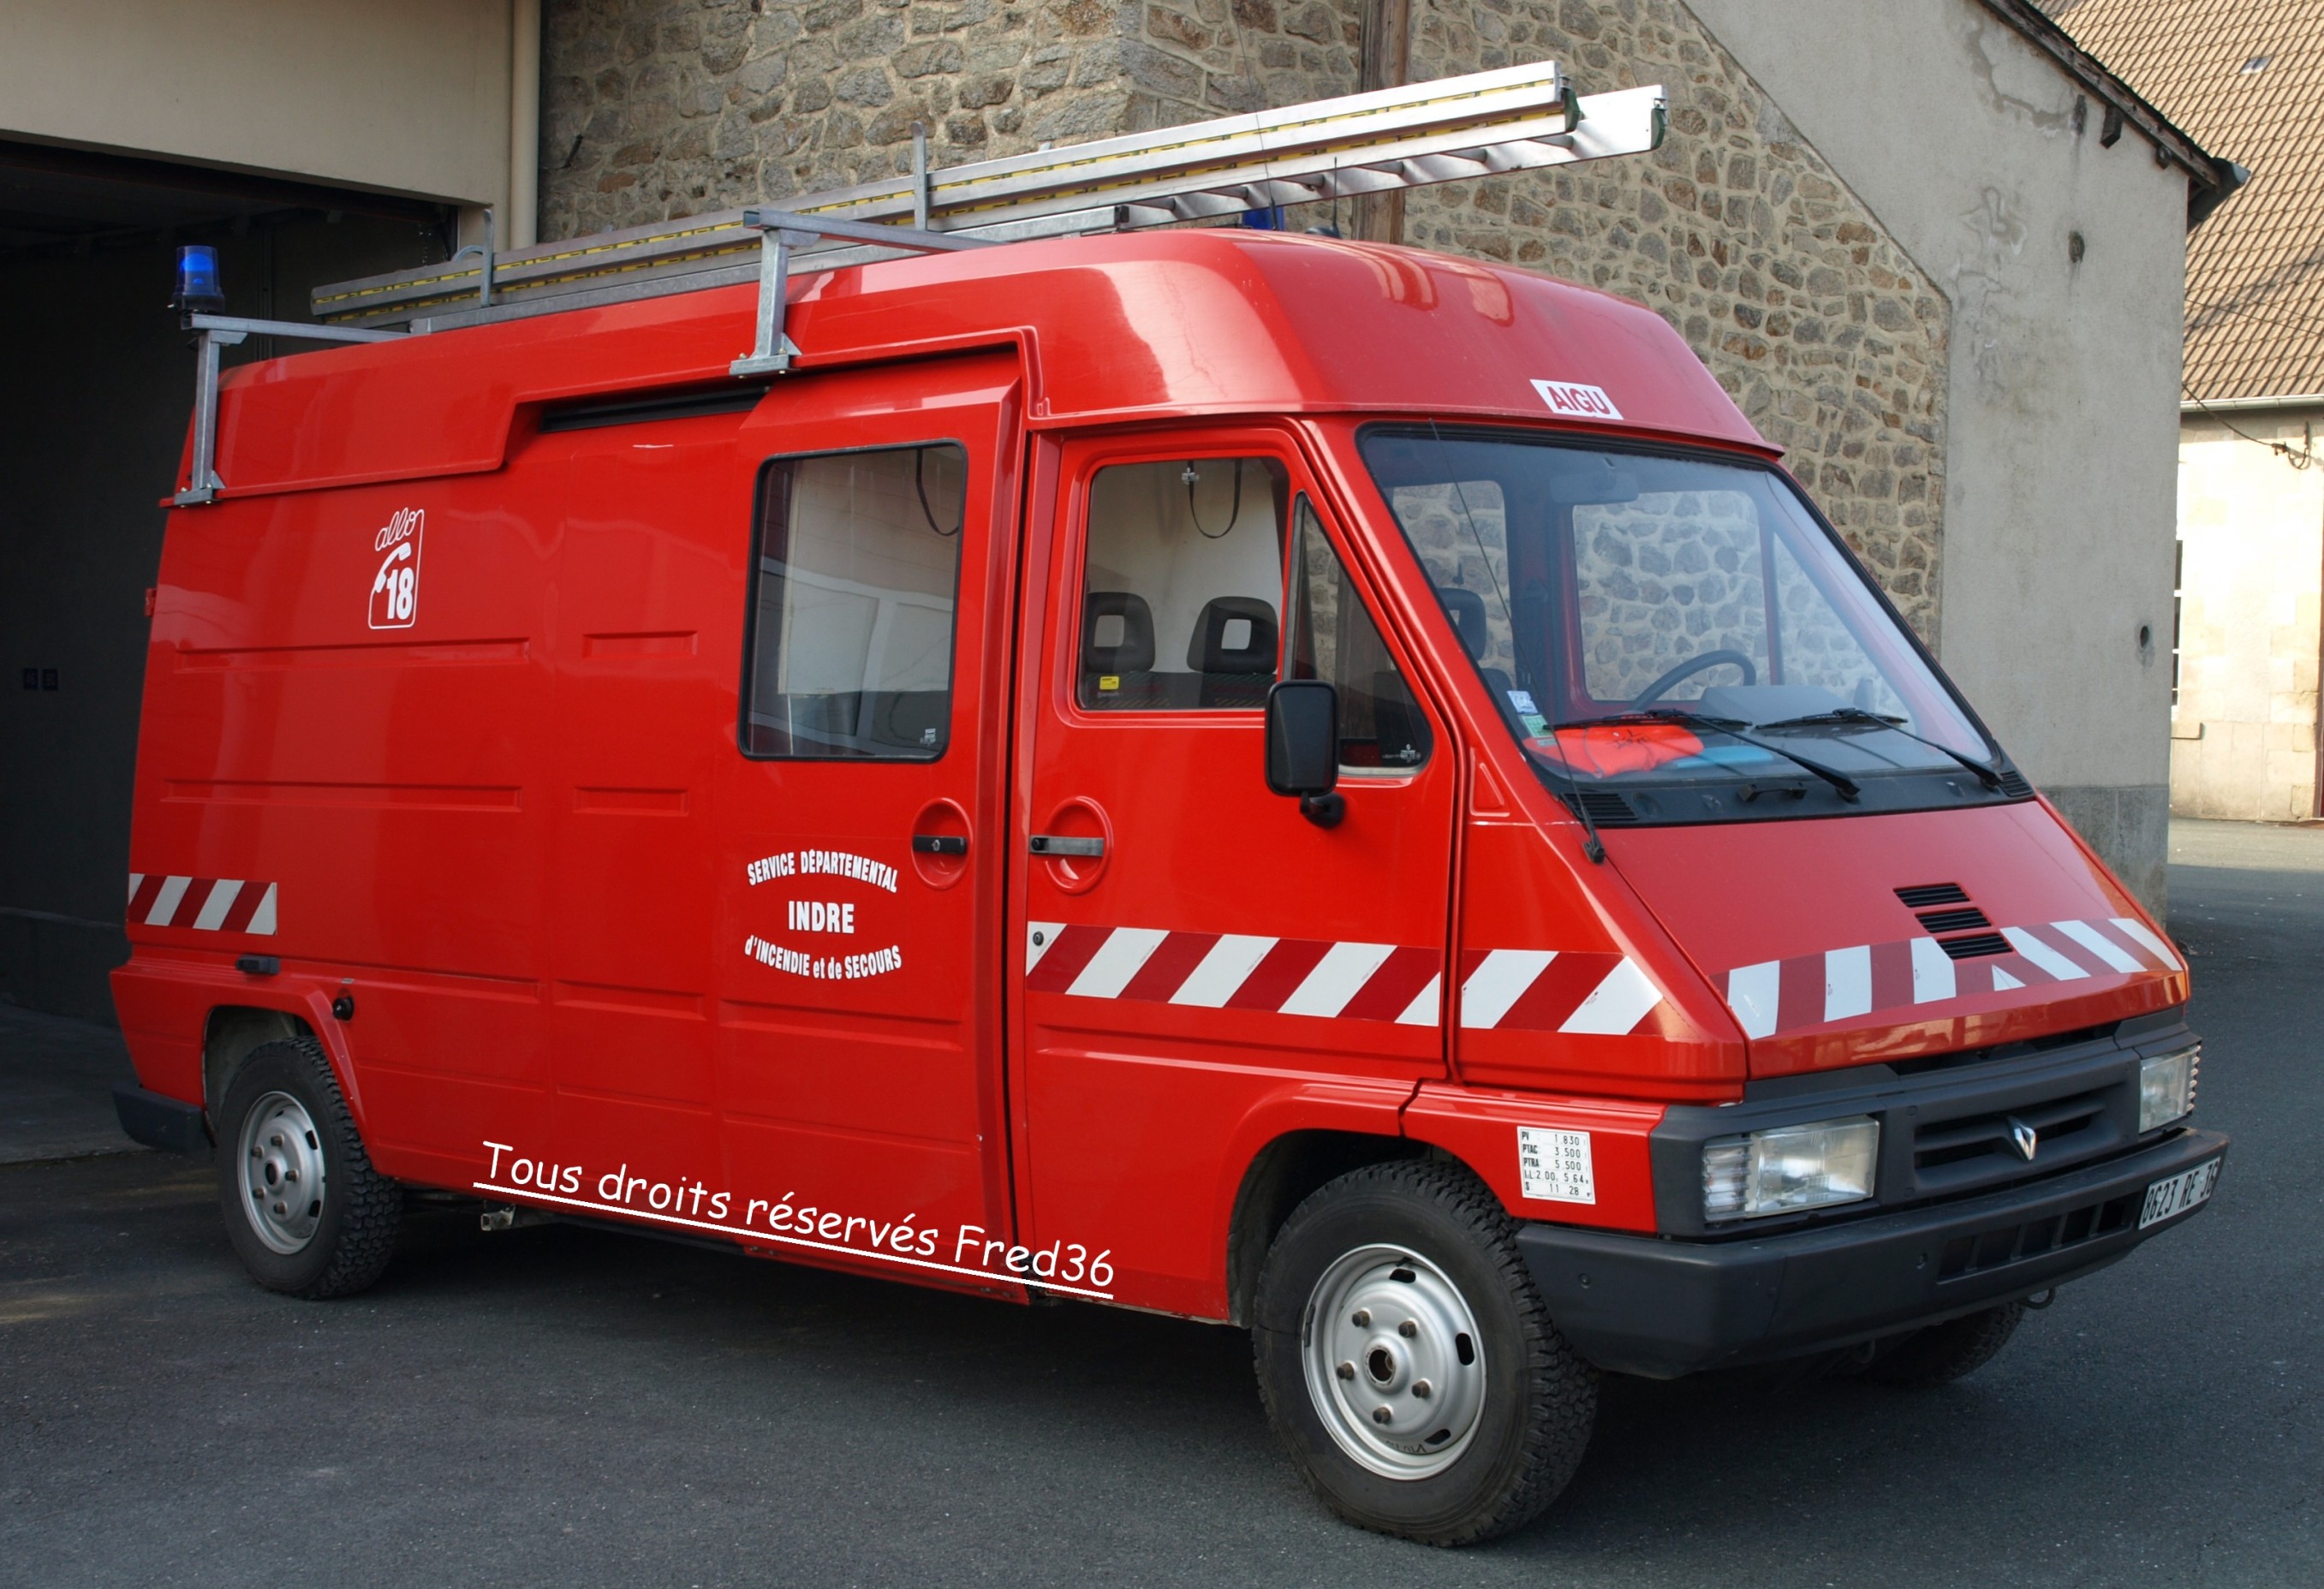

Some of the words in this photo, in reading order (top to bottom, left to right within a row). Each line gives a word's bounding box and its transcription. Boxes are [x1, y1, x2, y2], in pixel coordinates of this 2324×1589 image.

[1546, 386, 1611, 415] AIGU
[387, 567, 414, 620] 18
[747, 852, 796, 886] SERVICE
[800, 848, 898, 893] DÉPARTEMENTAL
[789, 901, 855, 934] INDRE
[744, 935, 810, 977] d'INCENDIE
[813, 957, 825, 979] et
[827, 956, 843, 979] de
[844, 944, 902, 979] SECOURS
[1523, 1144, 1538, 1154] PTAC
[1523, 1158, 1540, 1168] PTRA
[2142, 1178, 2179, 1224] 8623
[2178, 1169, 2200, 1210] RE
[2200, 1161, 2219, 1199] 36
